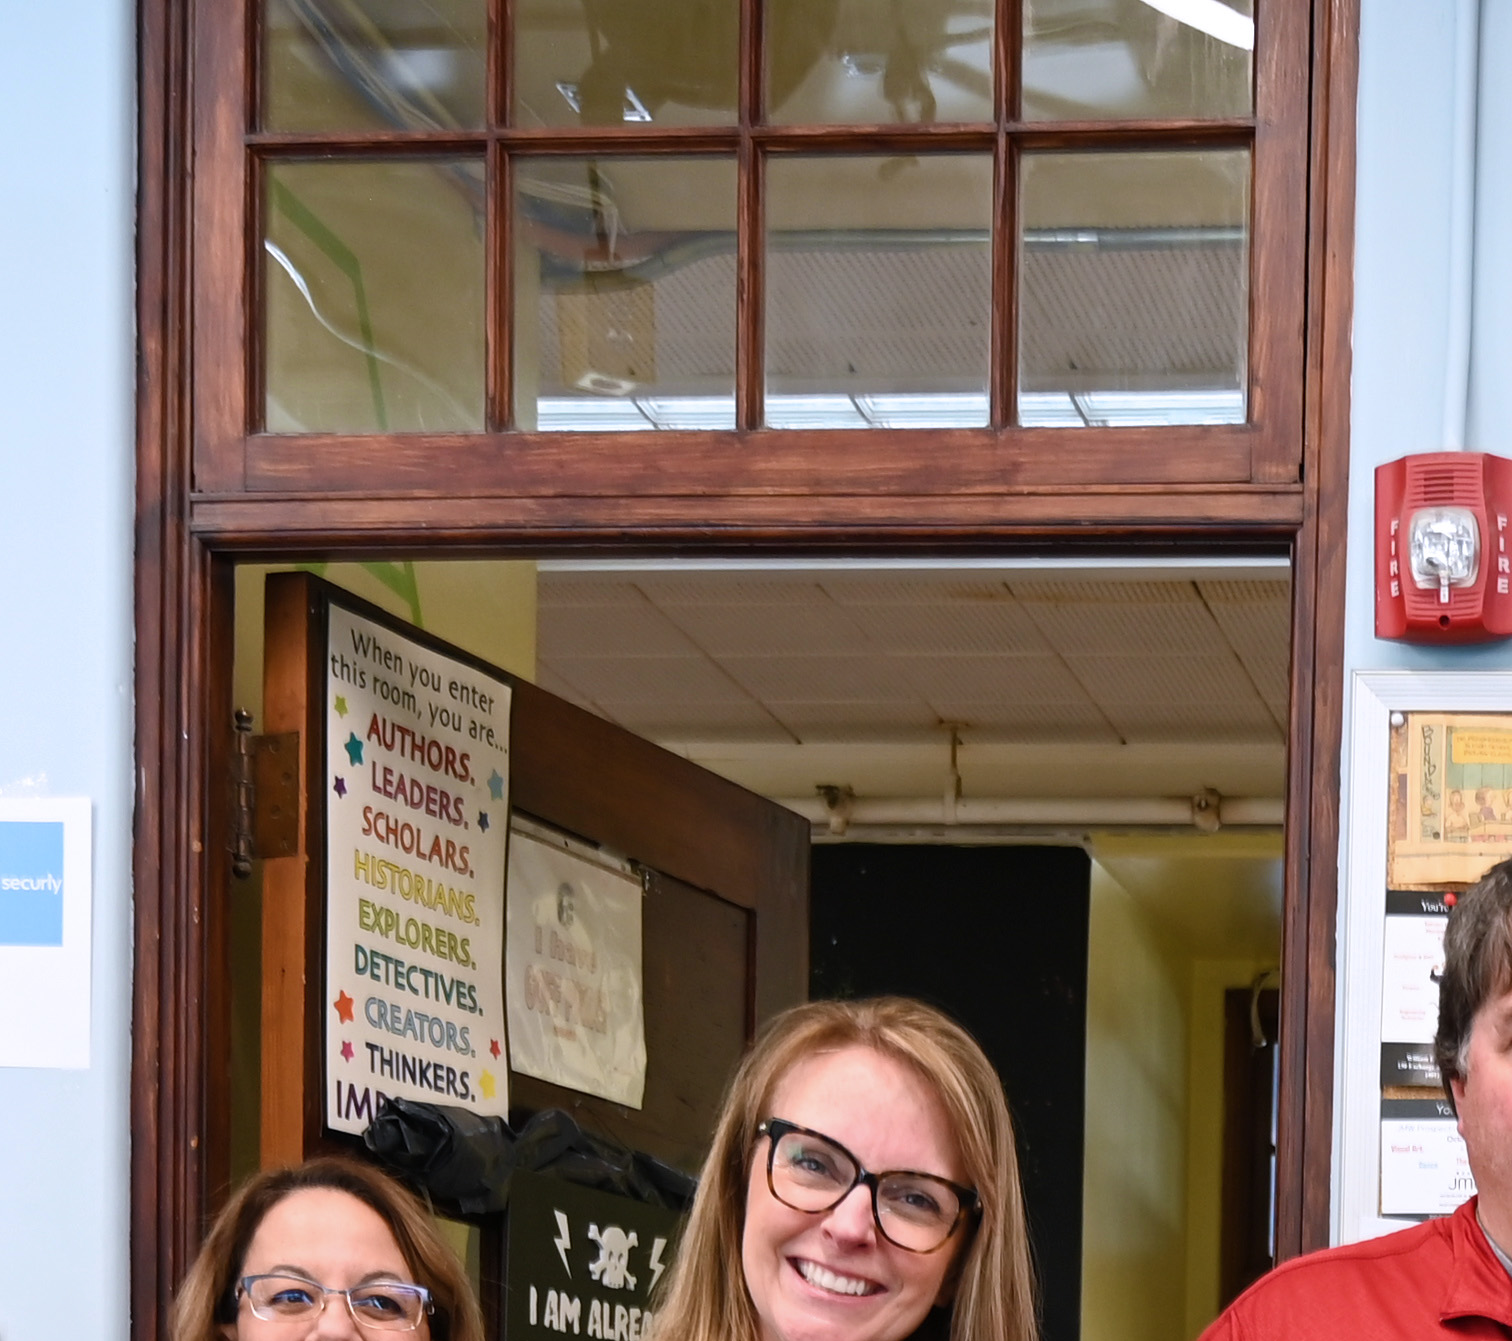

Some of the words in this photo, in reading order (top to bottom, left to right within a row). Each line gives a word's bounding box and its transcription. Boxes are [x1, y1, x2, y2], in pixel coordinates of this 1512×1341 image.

[1390, 519, 1400, 598] FIRE
[1496, 514, 1511, 594] FIRE
[331, 653, 367, 690] this
[373, 675, 422, 720] room,
[428, 701, 462, 733] you
[351, 628, 404, 676] When
[408, 661, 442, 693] you
[448, 680, 495, 715] enter
[367, 712, 476, 787] AUTHORS.
[371, 760, 469, 830] LEADERS.
[361, 805, 475, 879] SCHOLARS.
[1, 872, 63, 903] securly
[353, 848, 481, 927] HISTORIANS.
[358, 898, 477, 971] EXPLORERS.
[354, 943, 484, 1017] DETECTIVES.
[364, 996, 476, 1059] CREATORS.
[364, 1041, 476, 1103] THINKERS.
[529, 1284, 538, 1325] I
[544, 1289, 582, 1335] AM
